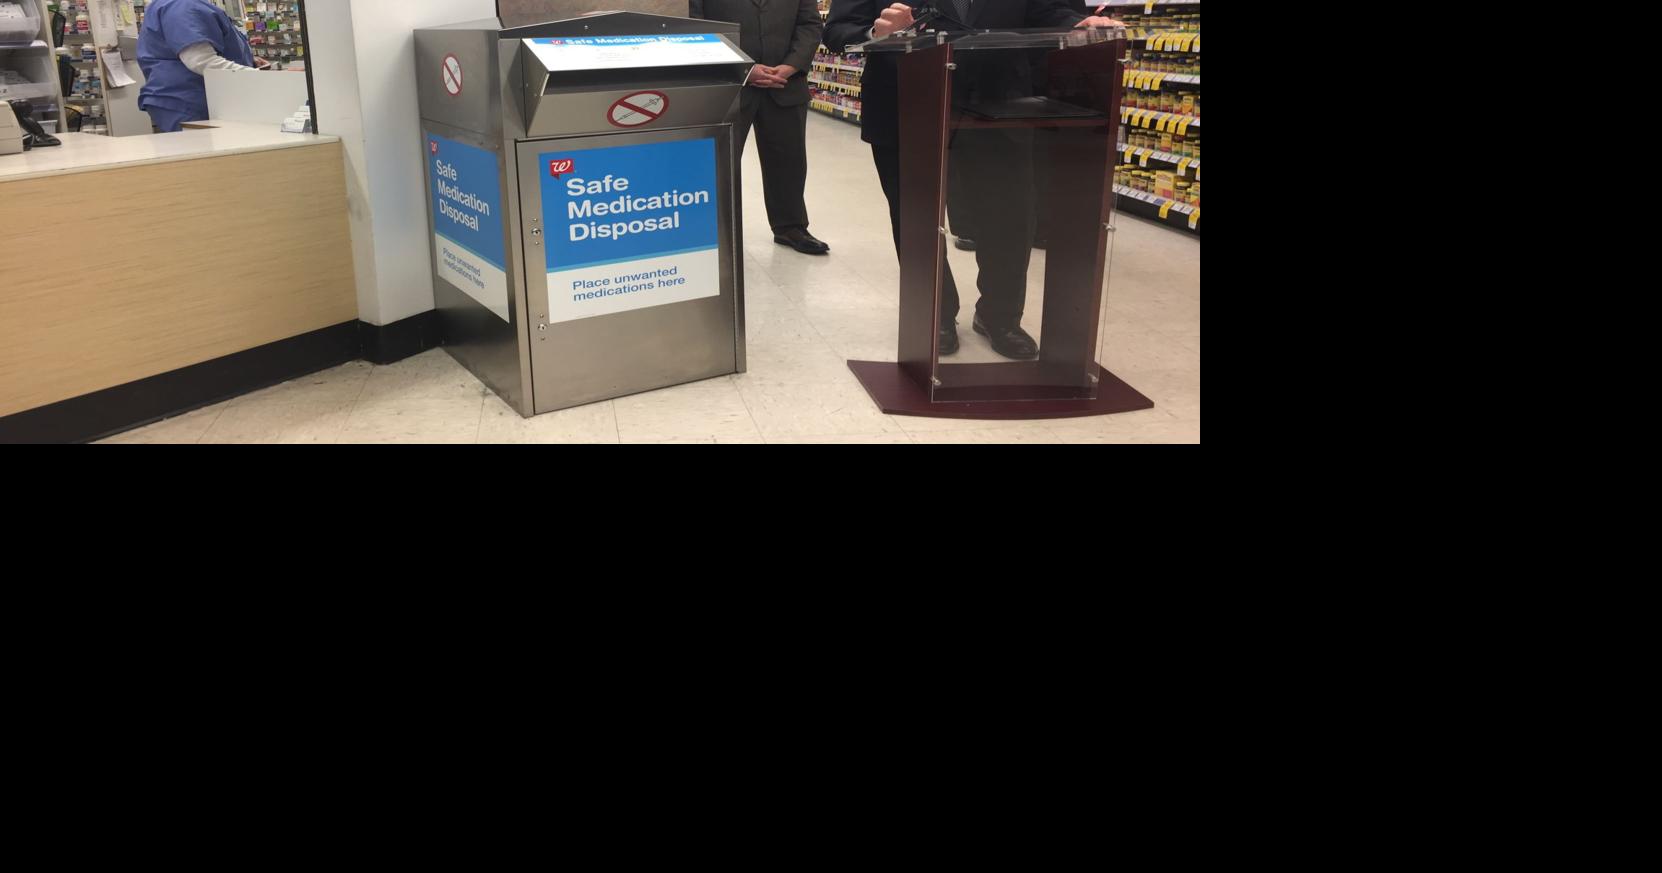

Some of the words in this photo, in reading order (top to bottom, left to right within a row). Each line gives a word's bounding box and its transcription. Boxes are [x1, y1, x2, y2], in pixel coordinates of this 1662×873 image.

[594, 36, 656, 44] Medication
[658, 35, 705, 43] Disposal
[436, 159, 457, 181] Safe
[437, 178, 490, 216] Medication
[566, 174, 629, 196] Safe
[439, 198, 479, 231] Disposal
[568, 189, 709, 219] Medication
[569, 211, 680, 242] Disposal
[456, 257, 481, 277] unwanted
[572, 277, 610, 290] Place
[614, 266, 678, 284] unwanted
[472, 275, 485, 289] here
[573, 282, 655, 301] medications
[657, 276, 686, 289] here
